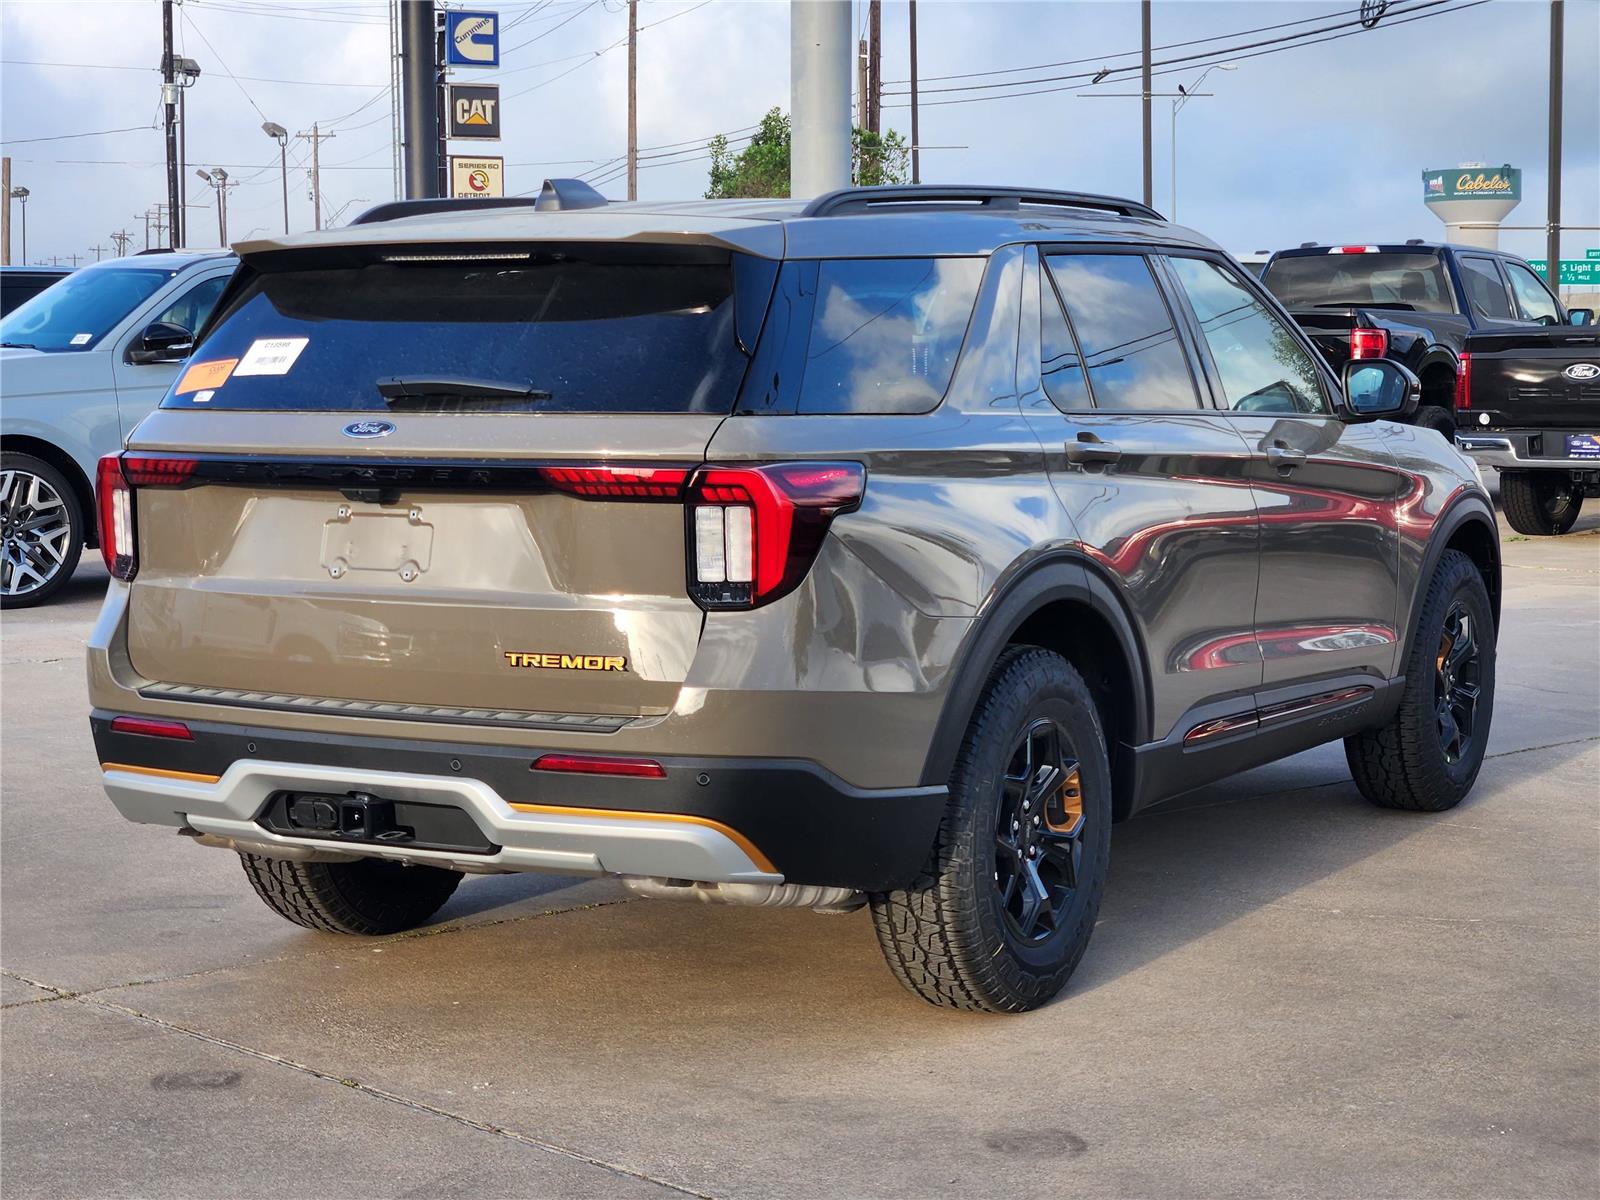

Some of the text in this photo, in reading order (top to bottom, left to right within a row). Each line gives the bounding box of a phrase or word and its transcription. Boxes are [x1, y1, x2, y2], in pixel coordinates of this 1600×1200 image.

[455, 18, 490, 43] Cummins
[456, 98, 496, 125] CAT
[1561, 264, 1568, 272] S
[1570, 264, 1591, 274] Light
[505, 652, 628, 672] TREMOR
